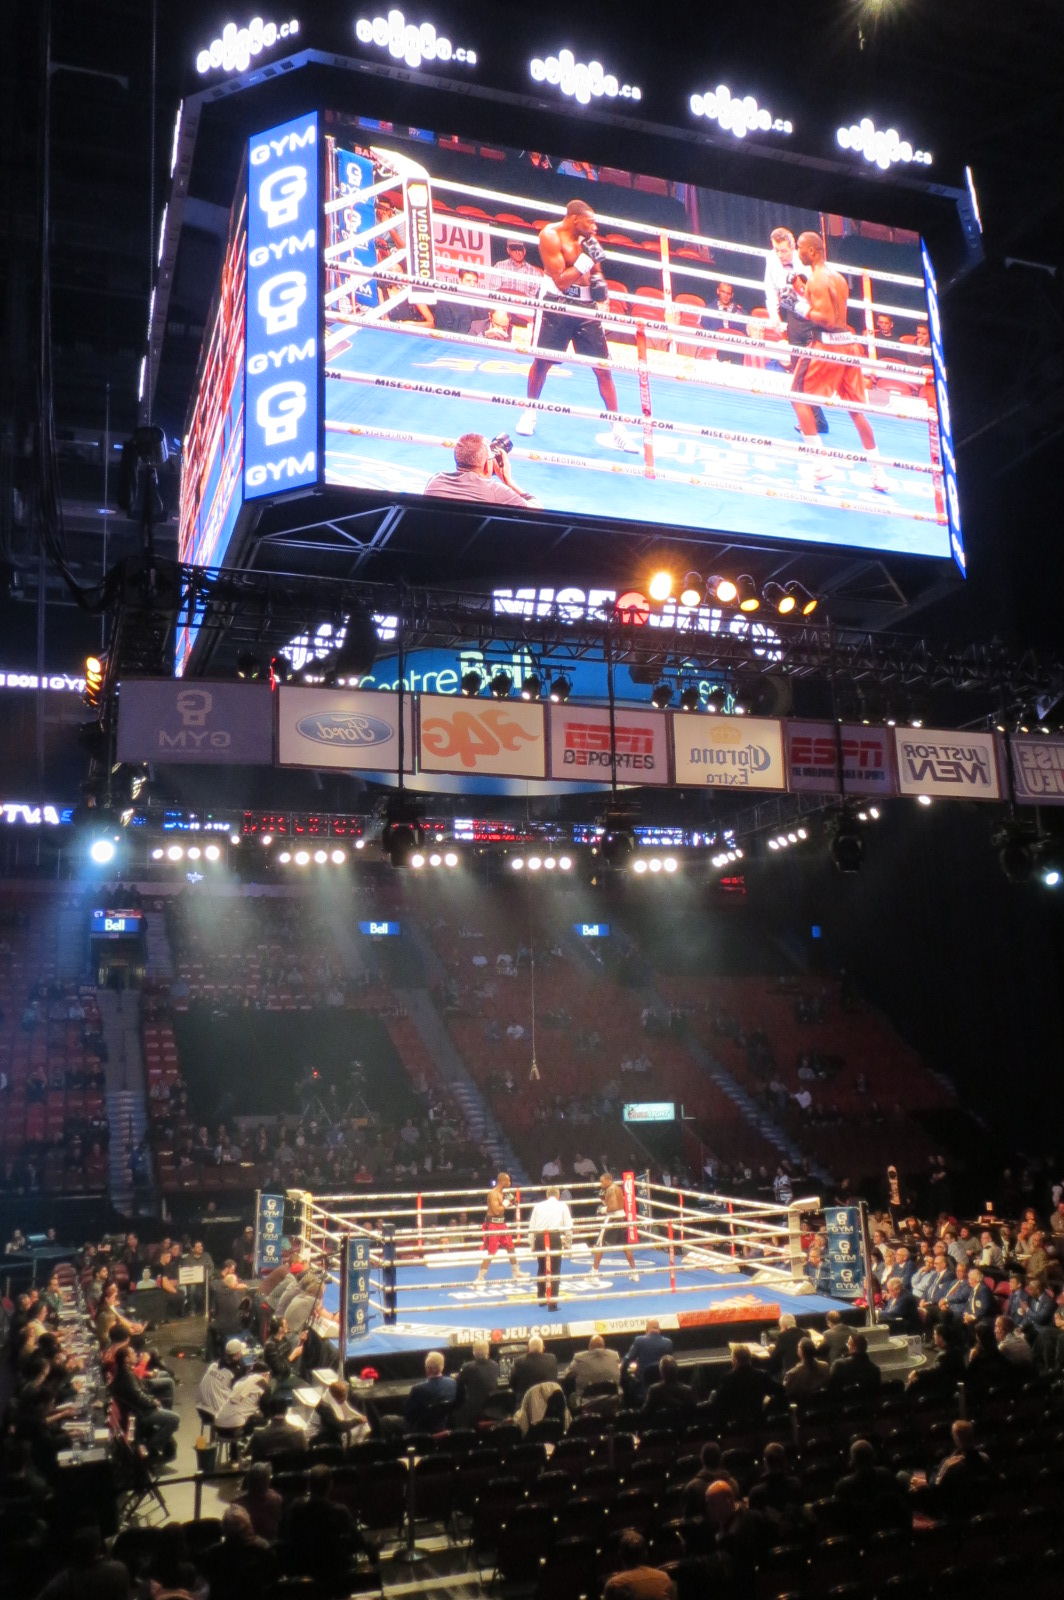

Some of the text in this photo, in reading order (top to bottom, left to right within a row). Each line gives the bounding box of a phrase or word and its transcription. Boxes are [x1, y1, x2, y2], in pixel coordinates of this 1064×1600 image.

[250, 125, 316, 165] GYM
[249, 229, 316, 267] GYM
[247, 338, 316, 375] GYM
[245, 451, 316, 486] GYM
[564, 722, 655, 754] ESPN
[791, 737, 883, 768] ESPN
[563, 749, 655, 769] DEPORTES
[104, 918, 126, 931] Bell
[369, 922, 389, 935] Bell
[582, 924, 600, 937] Bell
[609, 1319, 651, 1330] VIDÉOTR
